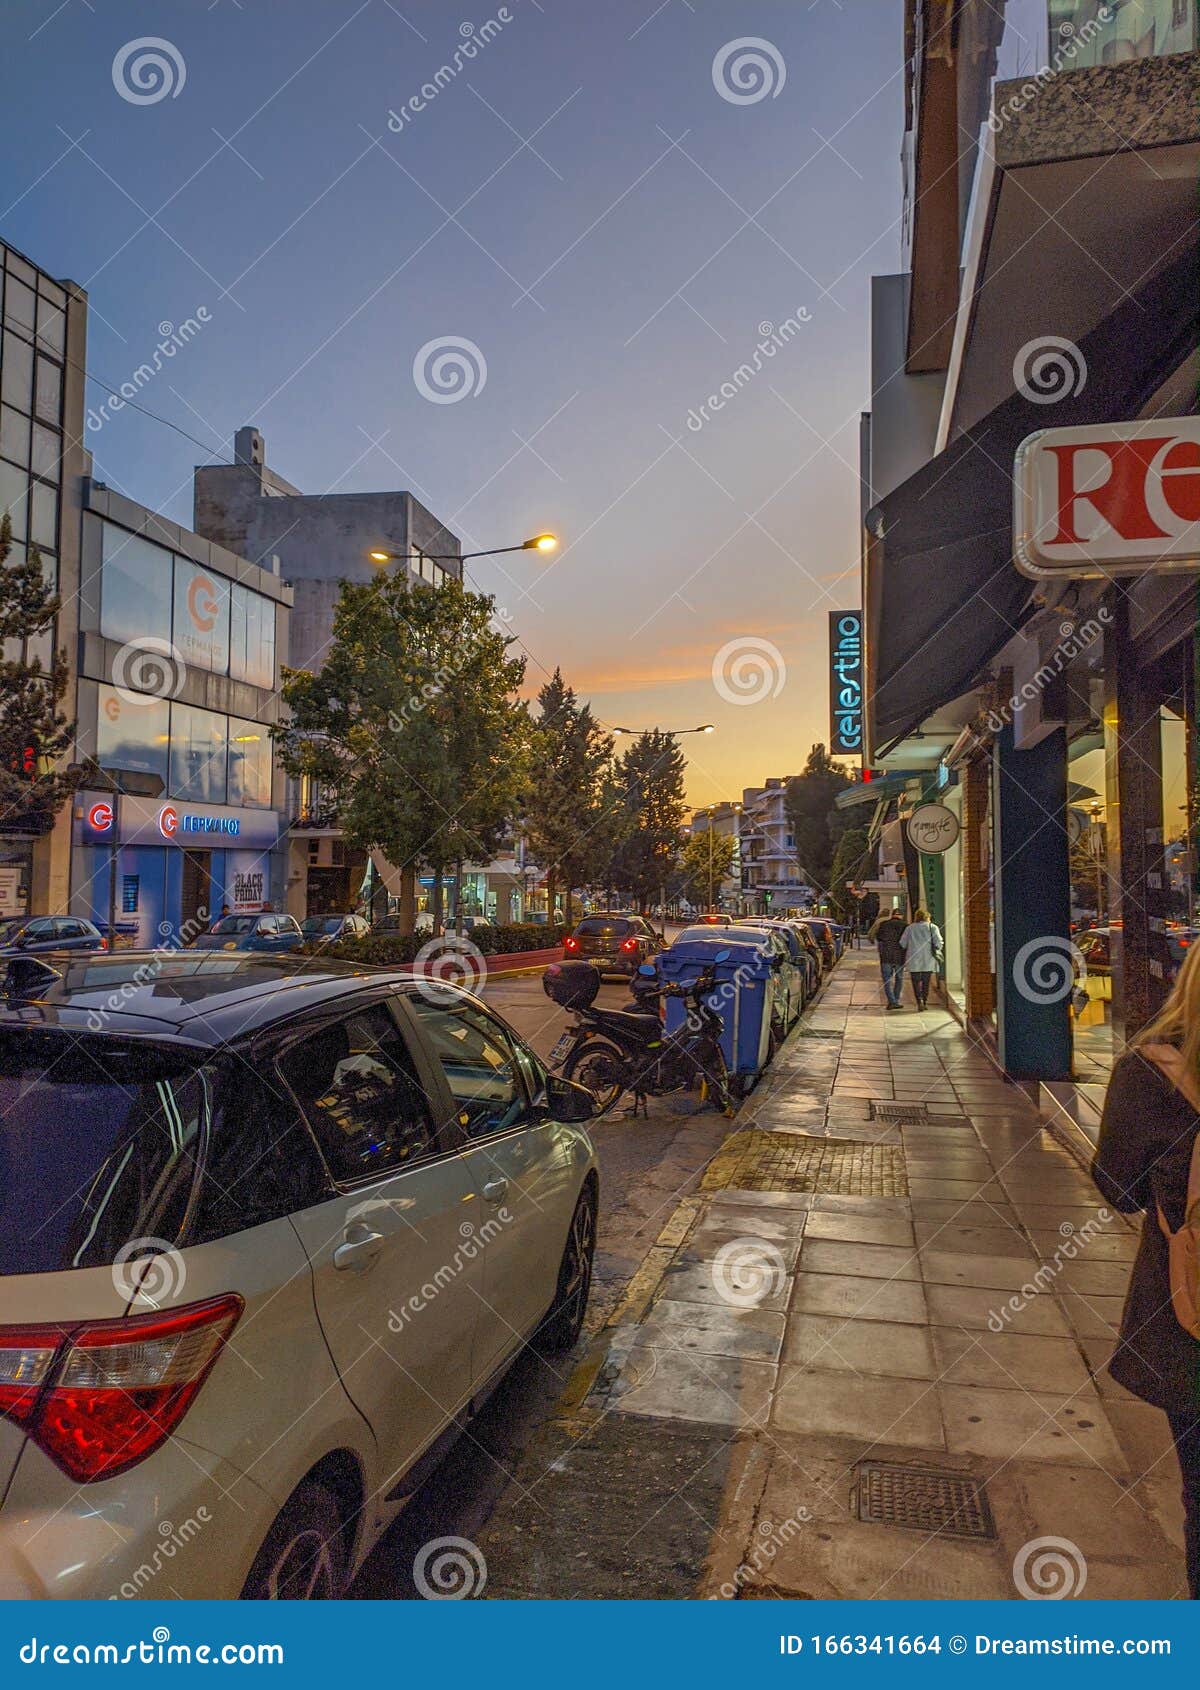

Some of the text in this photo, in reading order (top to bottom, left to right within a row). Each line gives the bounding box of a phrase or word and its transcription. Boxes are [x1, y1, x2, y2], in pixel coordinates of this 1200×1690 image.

[834, 616, 861, 748] celestino
[234, 872, 263, 889] BLACK
[234, 888, 263, 902] FRIDAY
